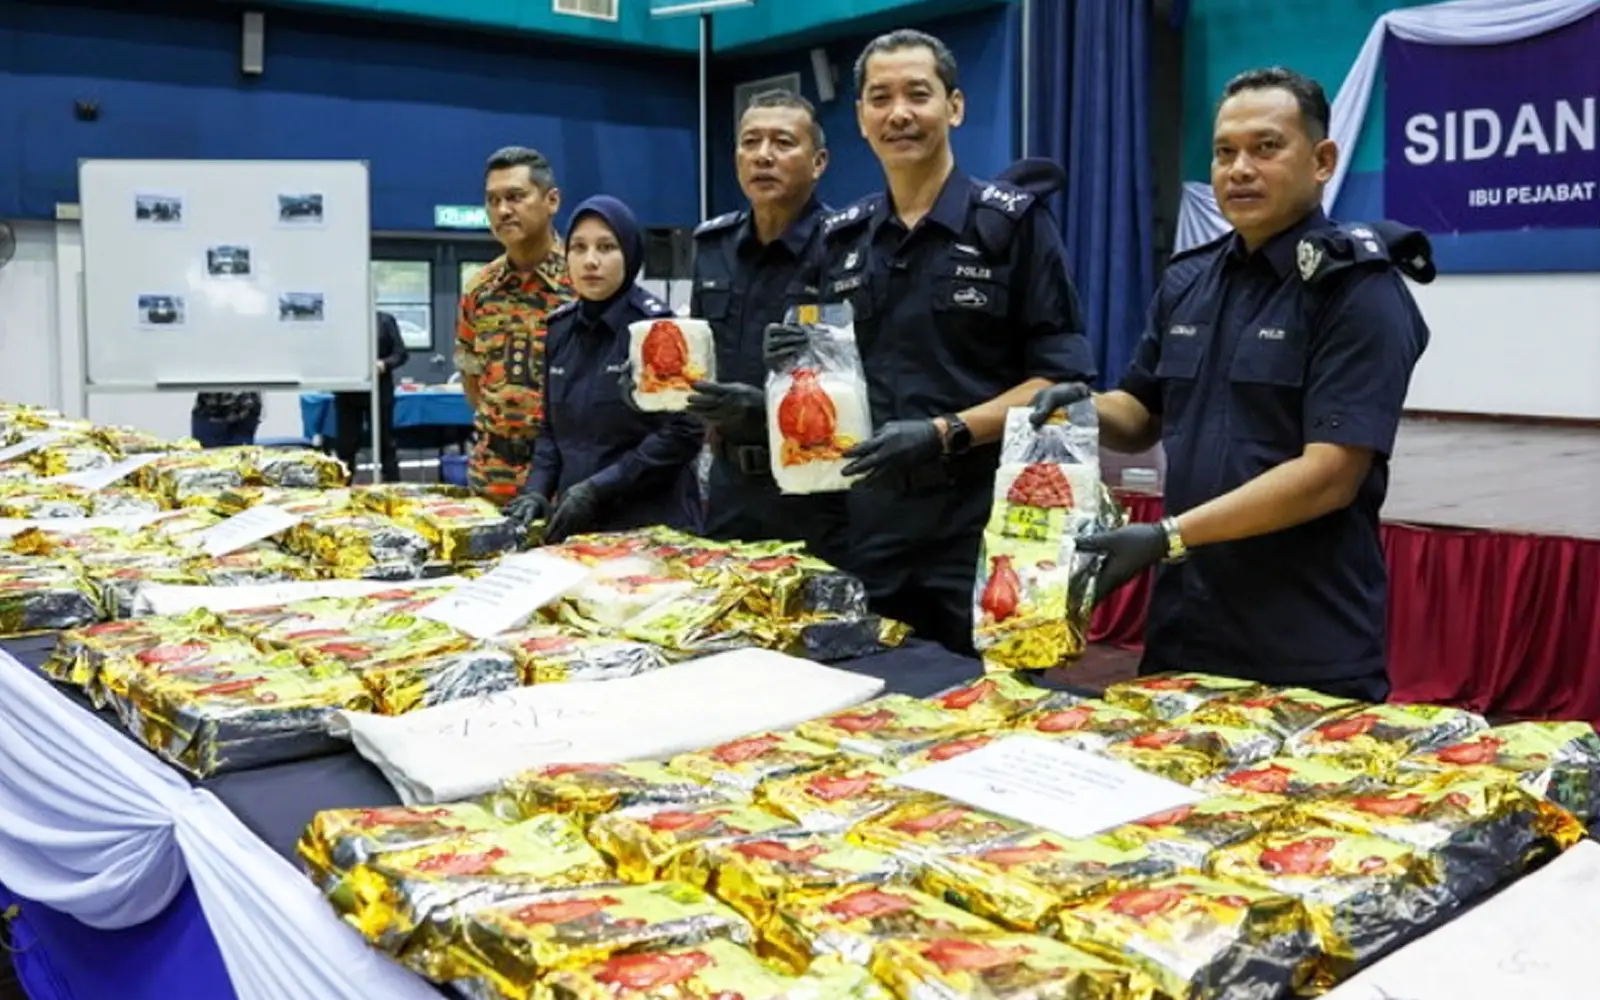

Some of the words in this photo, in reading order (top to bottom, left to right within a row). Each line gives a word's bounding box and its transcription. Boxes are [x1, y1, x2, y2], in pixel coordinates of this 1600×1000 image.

[1404, 97, 1596, 165] SIDAN
[1468, 188, 1501, 207] IBU
[1506, 181, 1596, 205] PEJABAT
